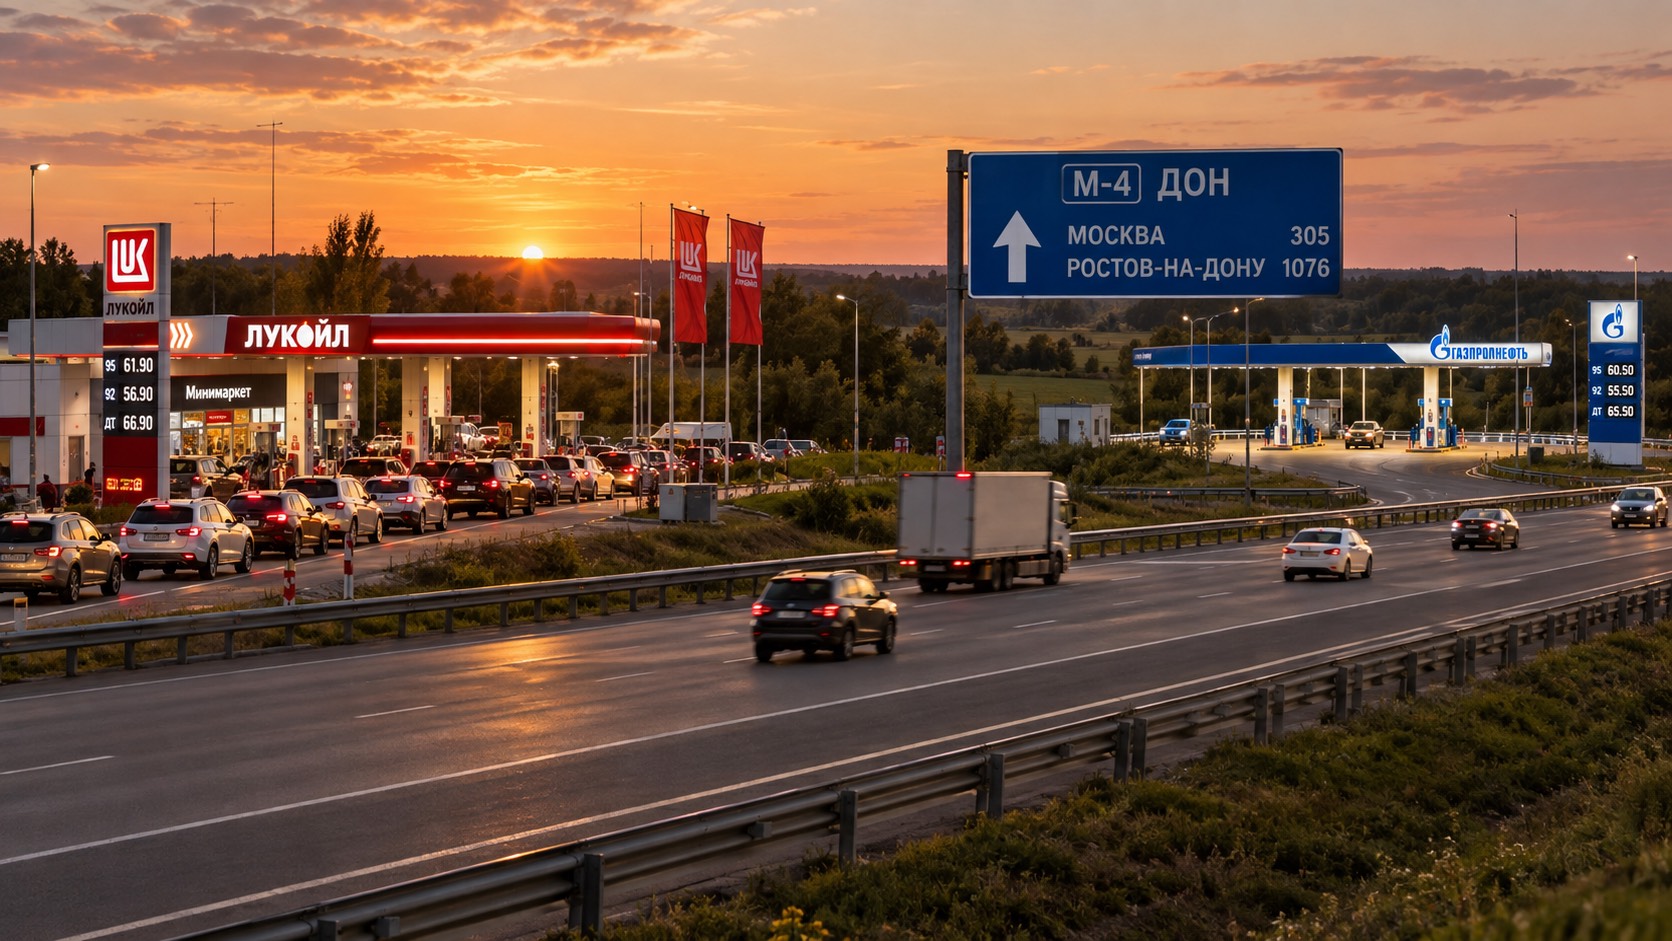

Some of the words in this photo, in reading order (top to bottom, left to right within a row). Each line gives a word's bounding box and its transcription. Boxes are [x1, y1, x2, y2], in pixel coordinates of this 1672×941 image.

[1073, 170, 1131, 197] М-4
[1158, 168, 1229, 202] ДОН
[1068, 225, 1165, 245] МОСКВА
[1290, 225, 1330, 246] 305
[1067, 257, 1266, 281] РОСТОВ-НА-ДОНУ
[1282, 258, 1330, 278] 1076
[106, 297, 154, 315] ЛУКОЙЛ
[244, 318, 350, 348] ЛУКОЙЛ
[105, 359, 116, 372] 95
[123, 357, 153, 373] 61.90
[1592, 366, 1602, 375] 95
[1607, 365, 1634, 376] 60.50
[105, 388, 116, 401] 92
[123, 386, 153, 402] 56.90
[186, 385, 252, 402] Минимаркет
[1592, 386, 1602, 395] 92
[1607, 385, 1634, 396] 55.50
[1592, 407, 1603, 416] ДТ
[1607, 406, 1634, 417] 65.50
[104, 417, 116, 430] ДТ
[123, 415, 153, 430] 66.90
